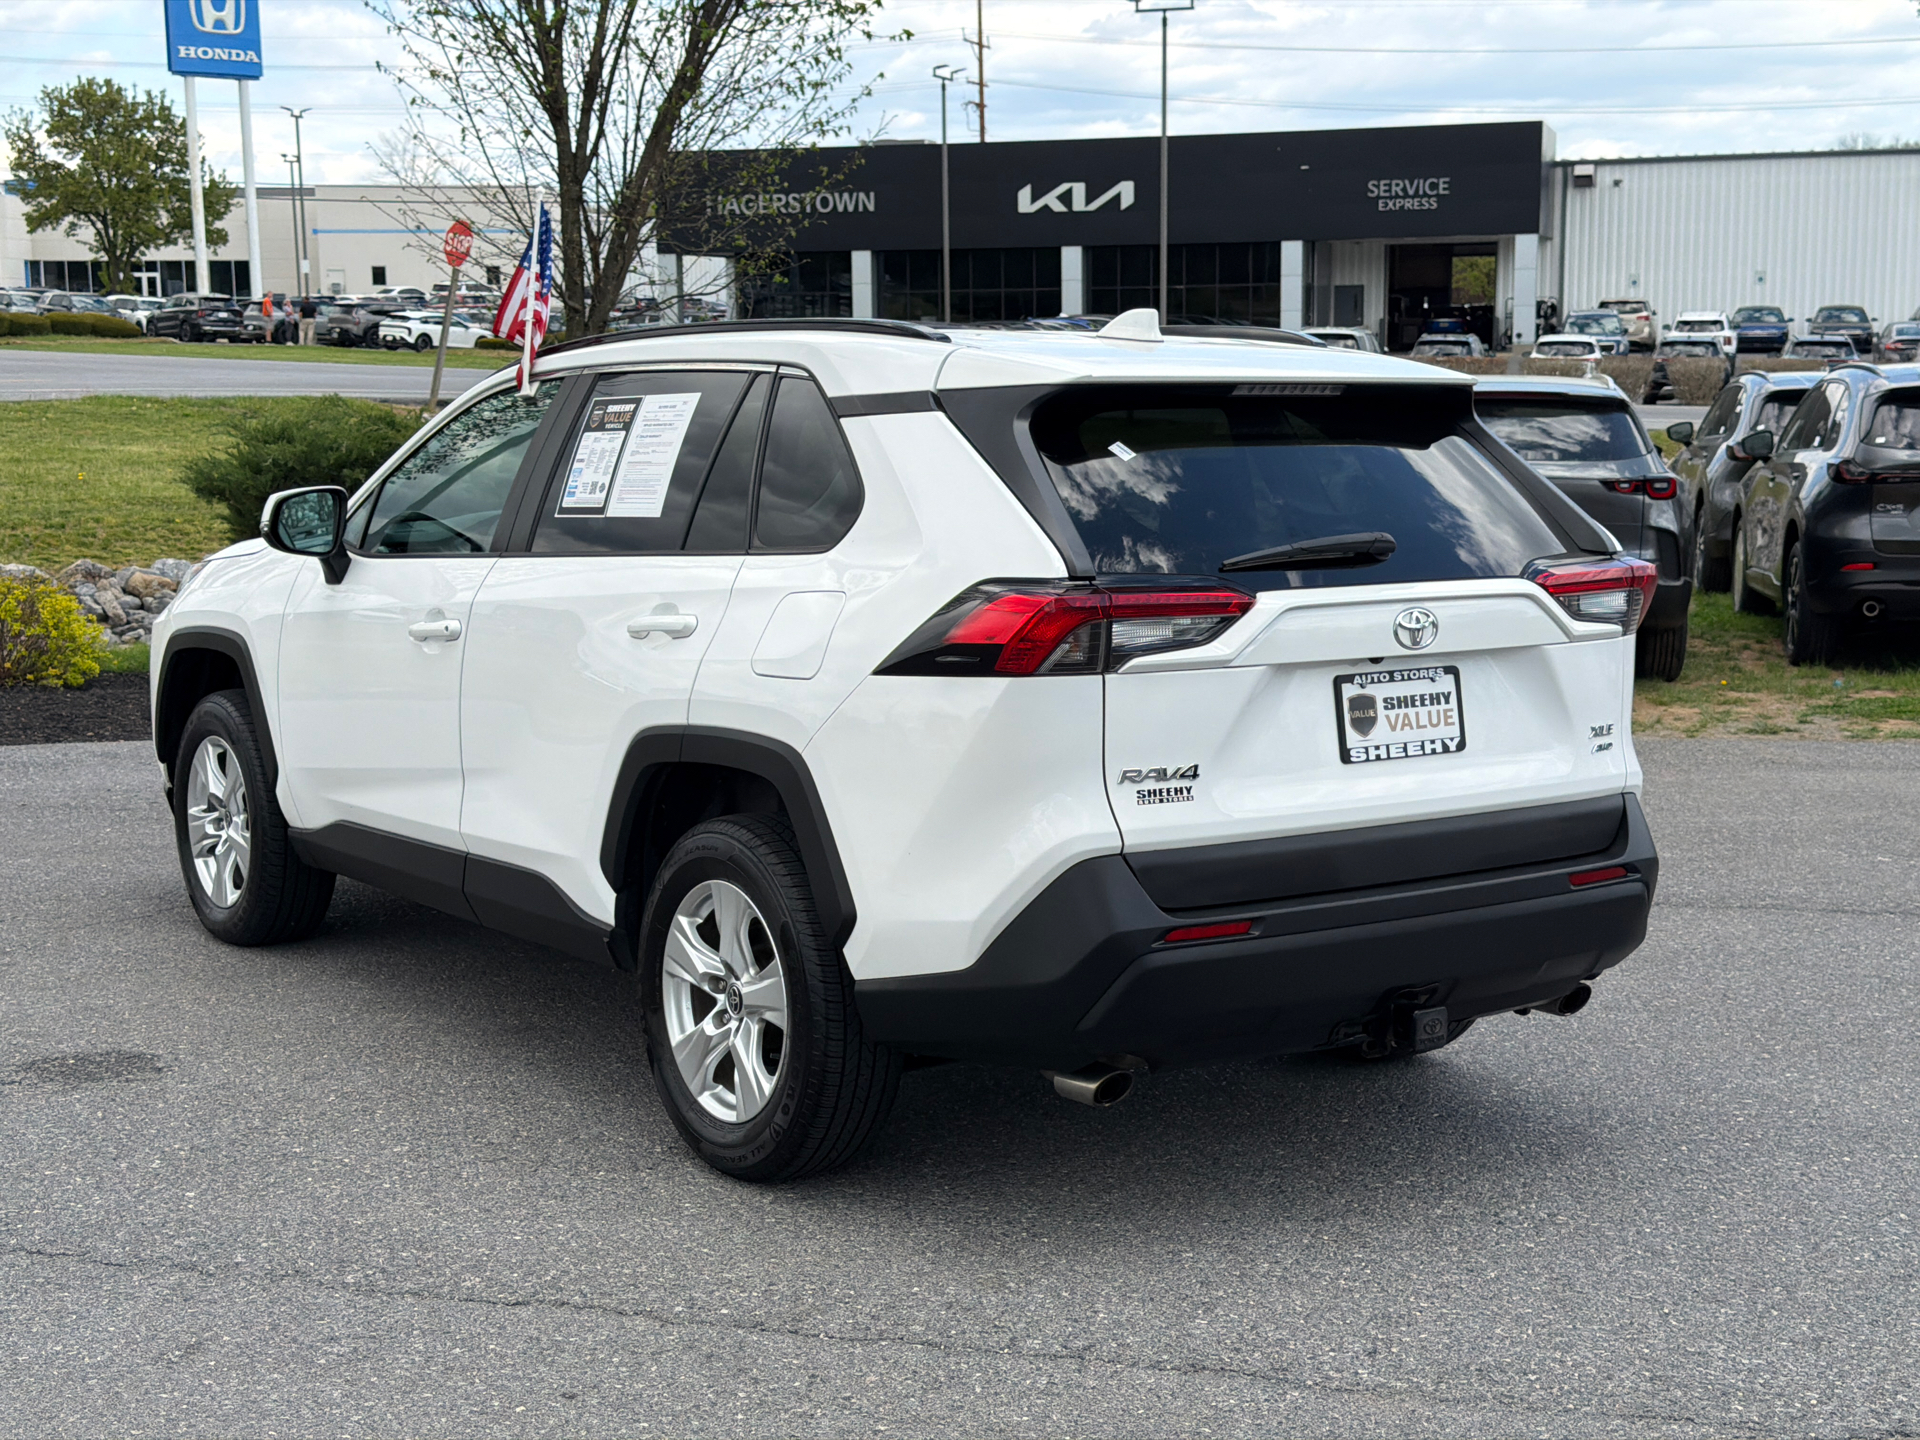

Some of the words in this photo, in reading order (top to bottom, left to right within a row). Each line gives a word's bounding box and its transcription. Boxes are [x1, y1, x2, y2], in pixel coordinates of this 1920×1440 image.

[177, 45, 261, 63] HONDA
[1017, 180, 1135, 213] KIA
[1367, 177, 1451, 197] SERVICE
[1378, 197, 1439, 212] EXPRESS
[446, 232, 473, 253] STOP
[603, 412, 633, 423] VALUE
[1353, 673, 1390, 685] AUTO
[1393, 668, 1445, 682] STORES
[1382, 691, 1452, 711] SHEEHY
[1350, 708, 1376, 719] VALUE
[1384, 708, 1456, 732] VALUE
[1350, 737, 1461, 763] SHEEHY
[1117, 763, 1200, 785] RAV4
[1136, 785, 1193, 799] SHEEHY
[1163, 795, 1193, 803] STORES
